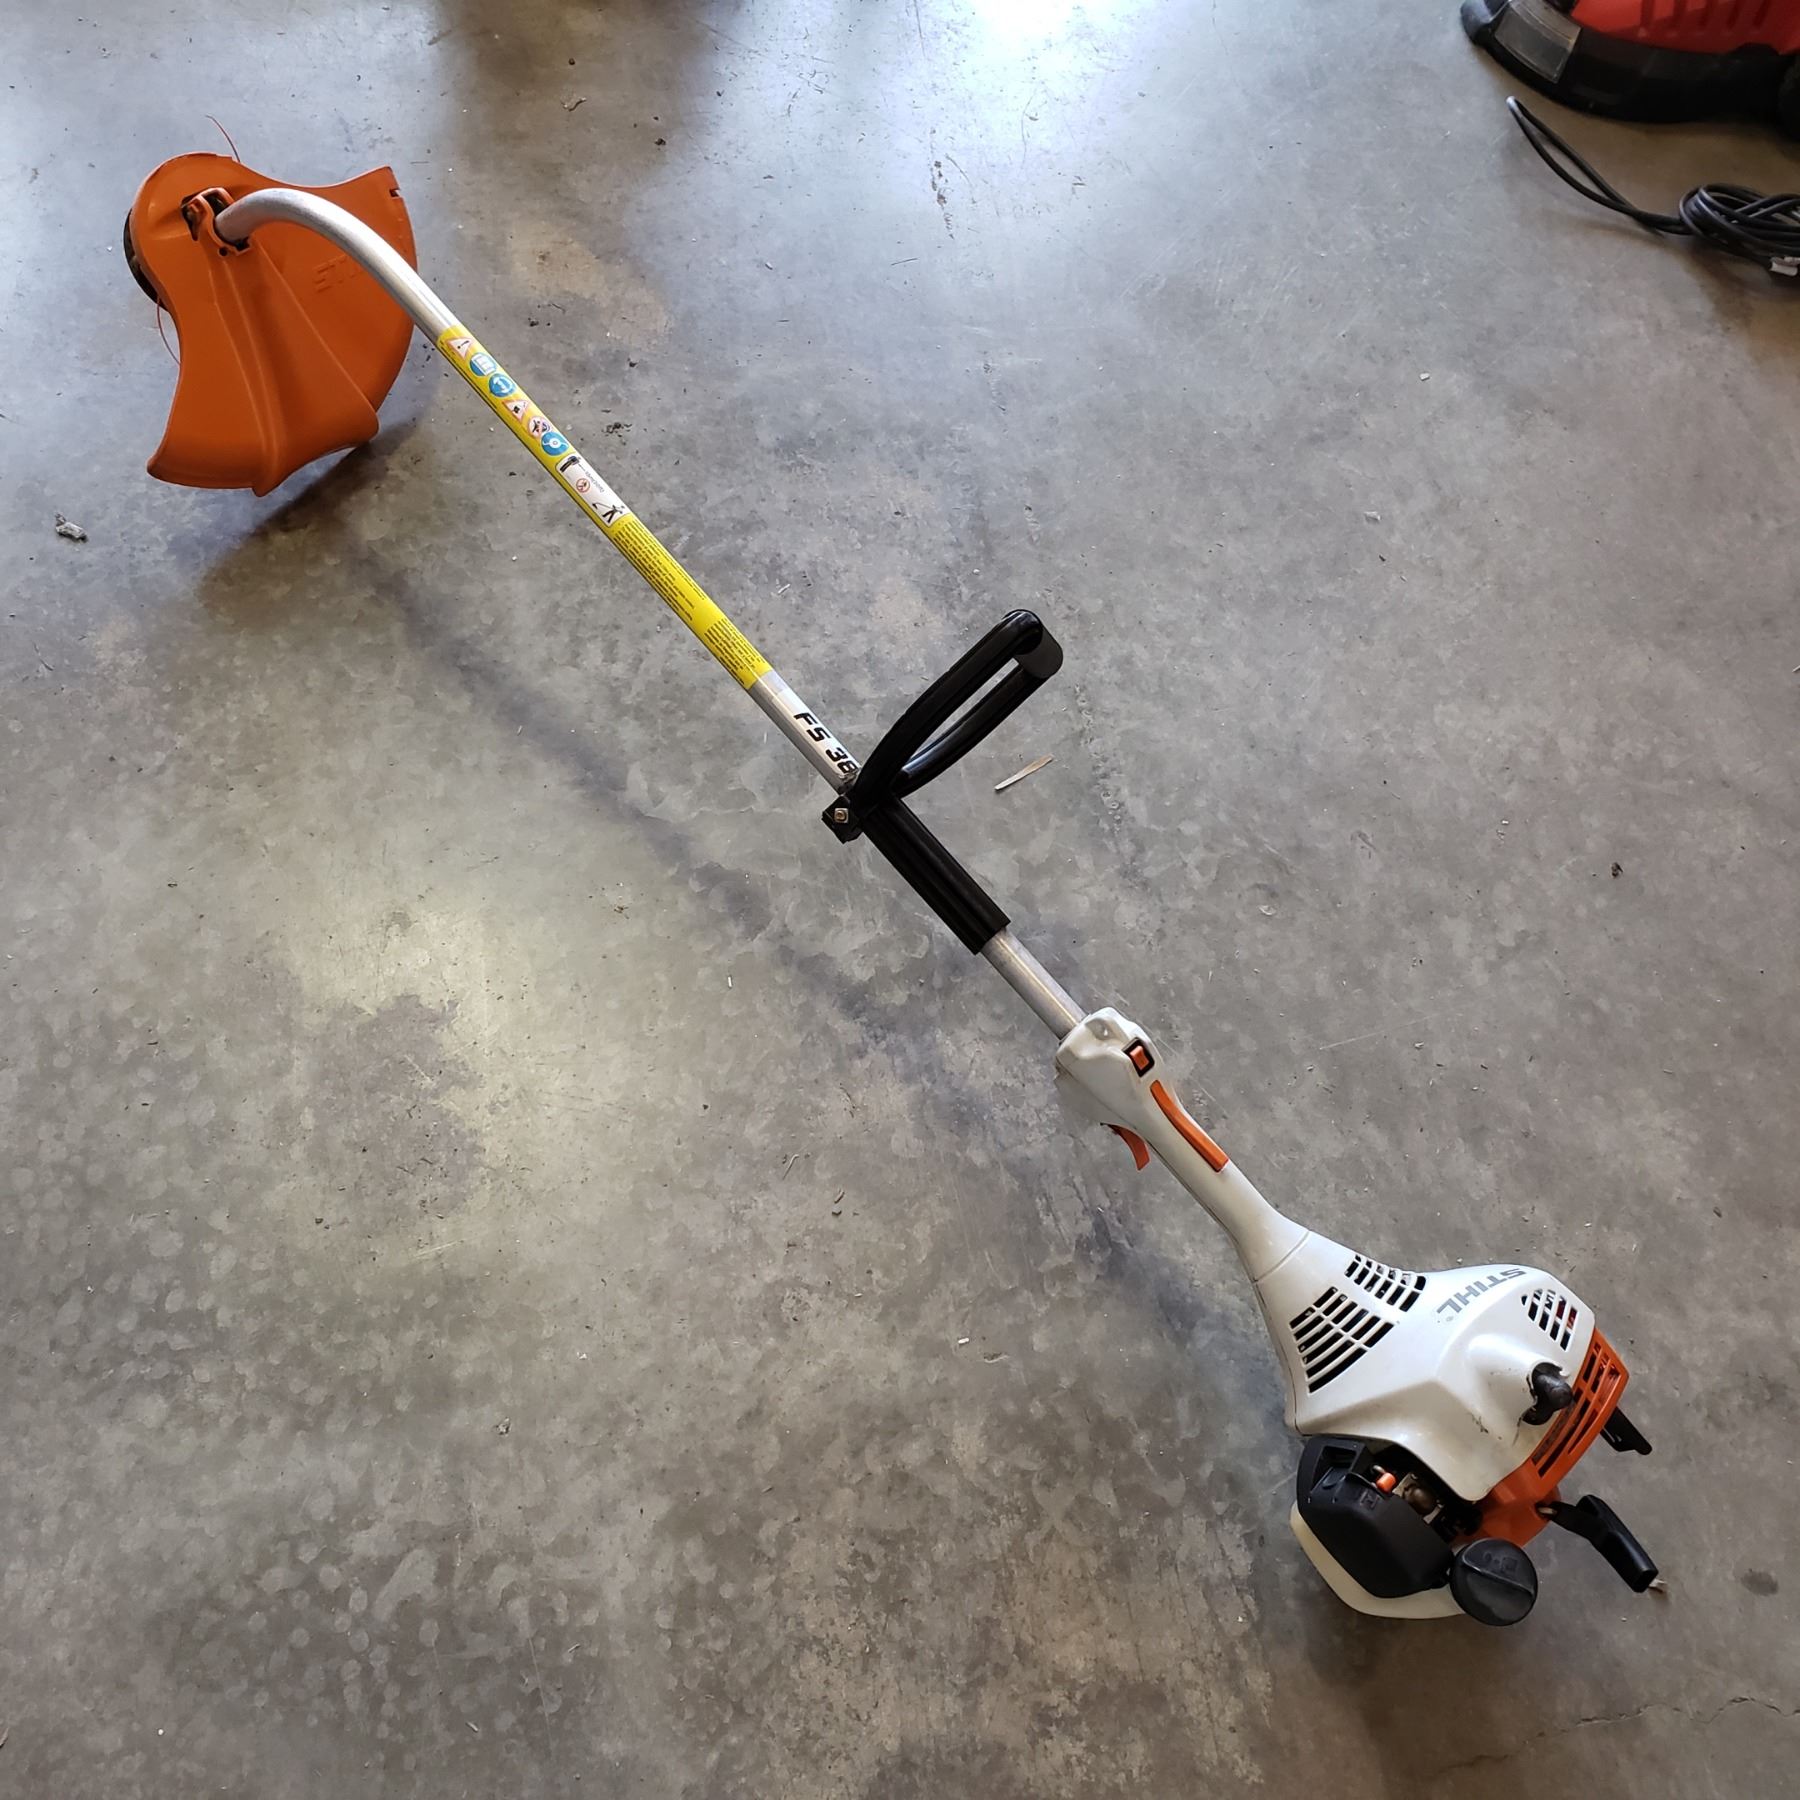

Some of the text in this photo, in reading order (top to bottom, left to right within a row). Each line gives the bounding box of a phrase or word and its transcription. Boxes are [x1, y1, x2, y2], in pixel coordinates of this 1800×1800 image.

[793, 712, 859, 774] FS 38
[1436, 1268, 1527, 1314] STIHL
